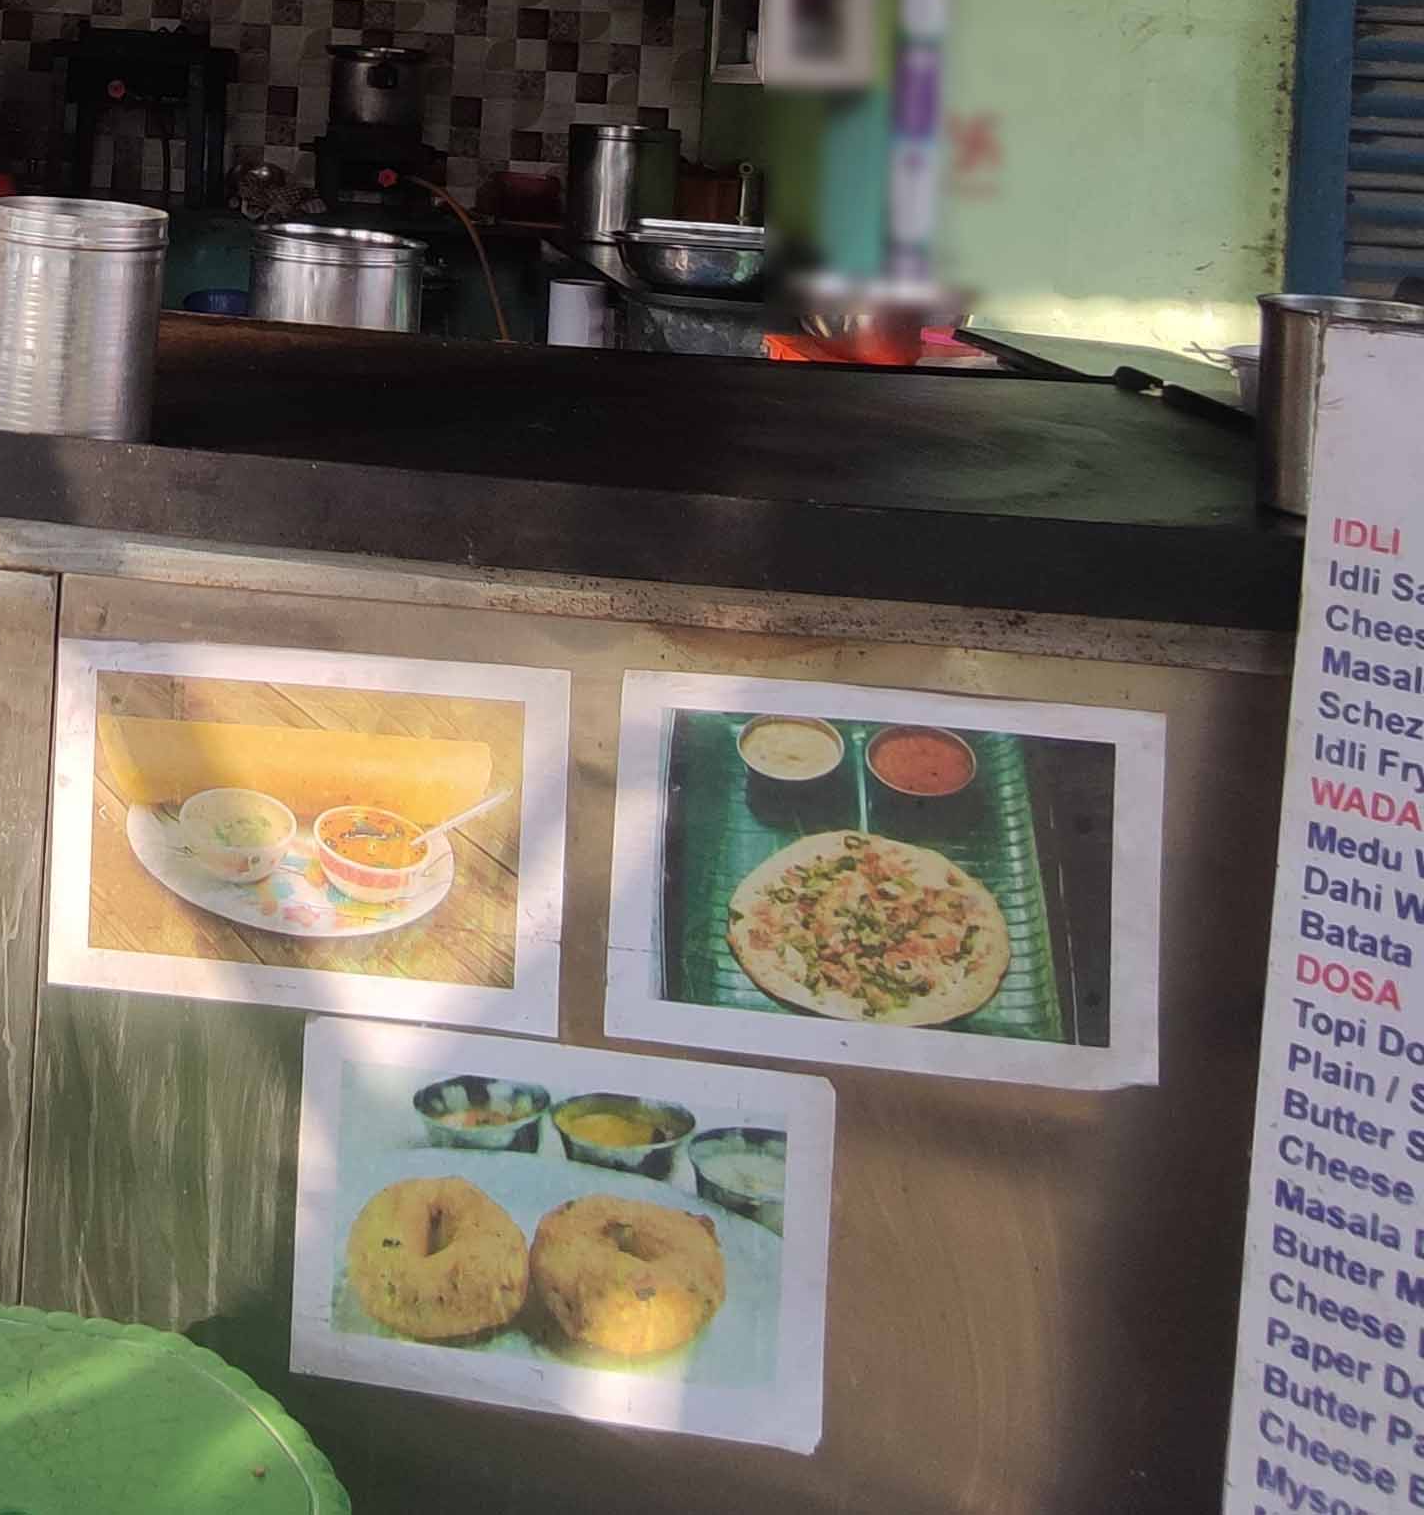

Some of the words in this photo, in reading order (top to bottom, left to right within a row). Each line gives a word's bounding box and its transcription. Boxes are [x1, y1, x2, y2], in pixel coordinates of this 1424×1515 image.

[1333, 517, 1401, 556] IDLI
[1329, 560, 1380, 596] Idli
[1314, 733, 1366, 771] Idli
[1311, 776, 1422, 831] WADA
[1307, 822, 1403, 872] Medu
[1303, 865, 1382, 913] Dahi
[1300, 909, 1412, 968] Batata
[1296, 953, 1402, 1011] DOSA
[1292, 997, 1366, 1048] Topi
[1287, 1042, 1375, 1098] Plain
[1283, 1087, 1395, 1150] Butter
[1278, 1134, 1414, 1205] Cheese
[1275, 1178, 1401, 1251] Masala
[1272, 1222, 1385, 1290] Butter
[1269, 1272, 1407, 1349] Cheese
[1266, 1316, 1372, 1384] Paper
[1263, 1364, 1377, 1435] Butter
[1259, 1408, 1397, 1495] Cheese
